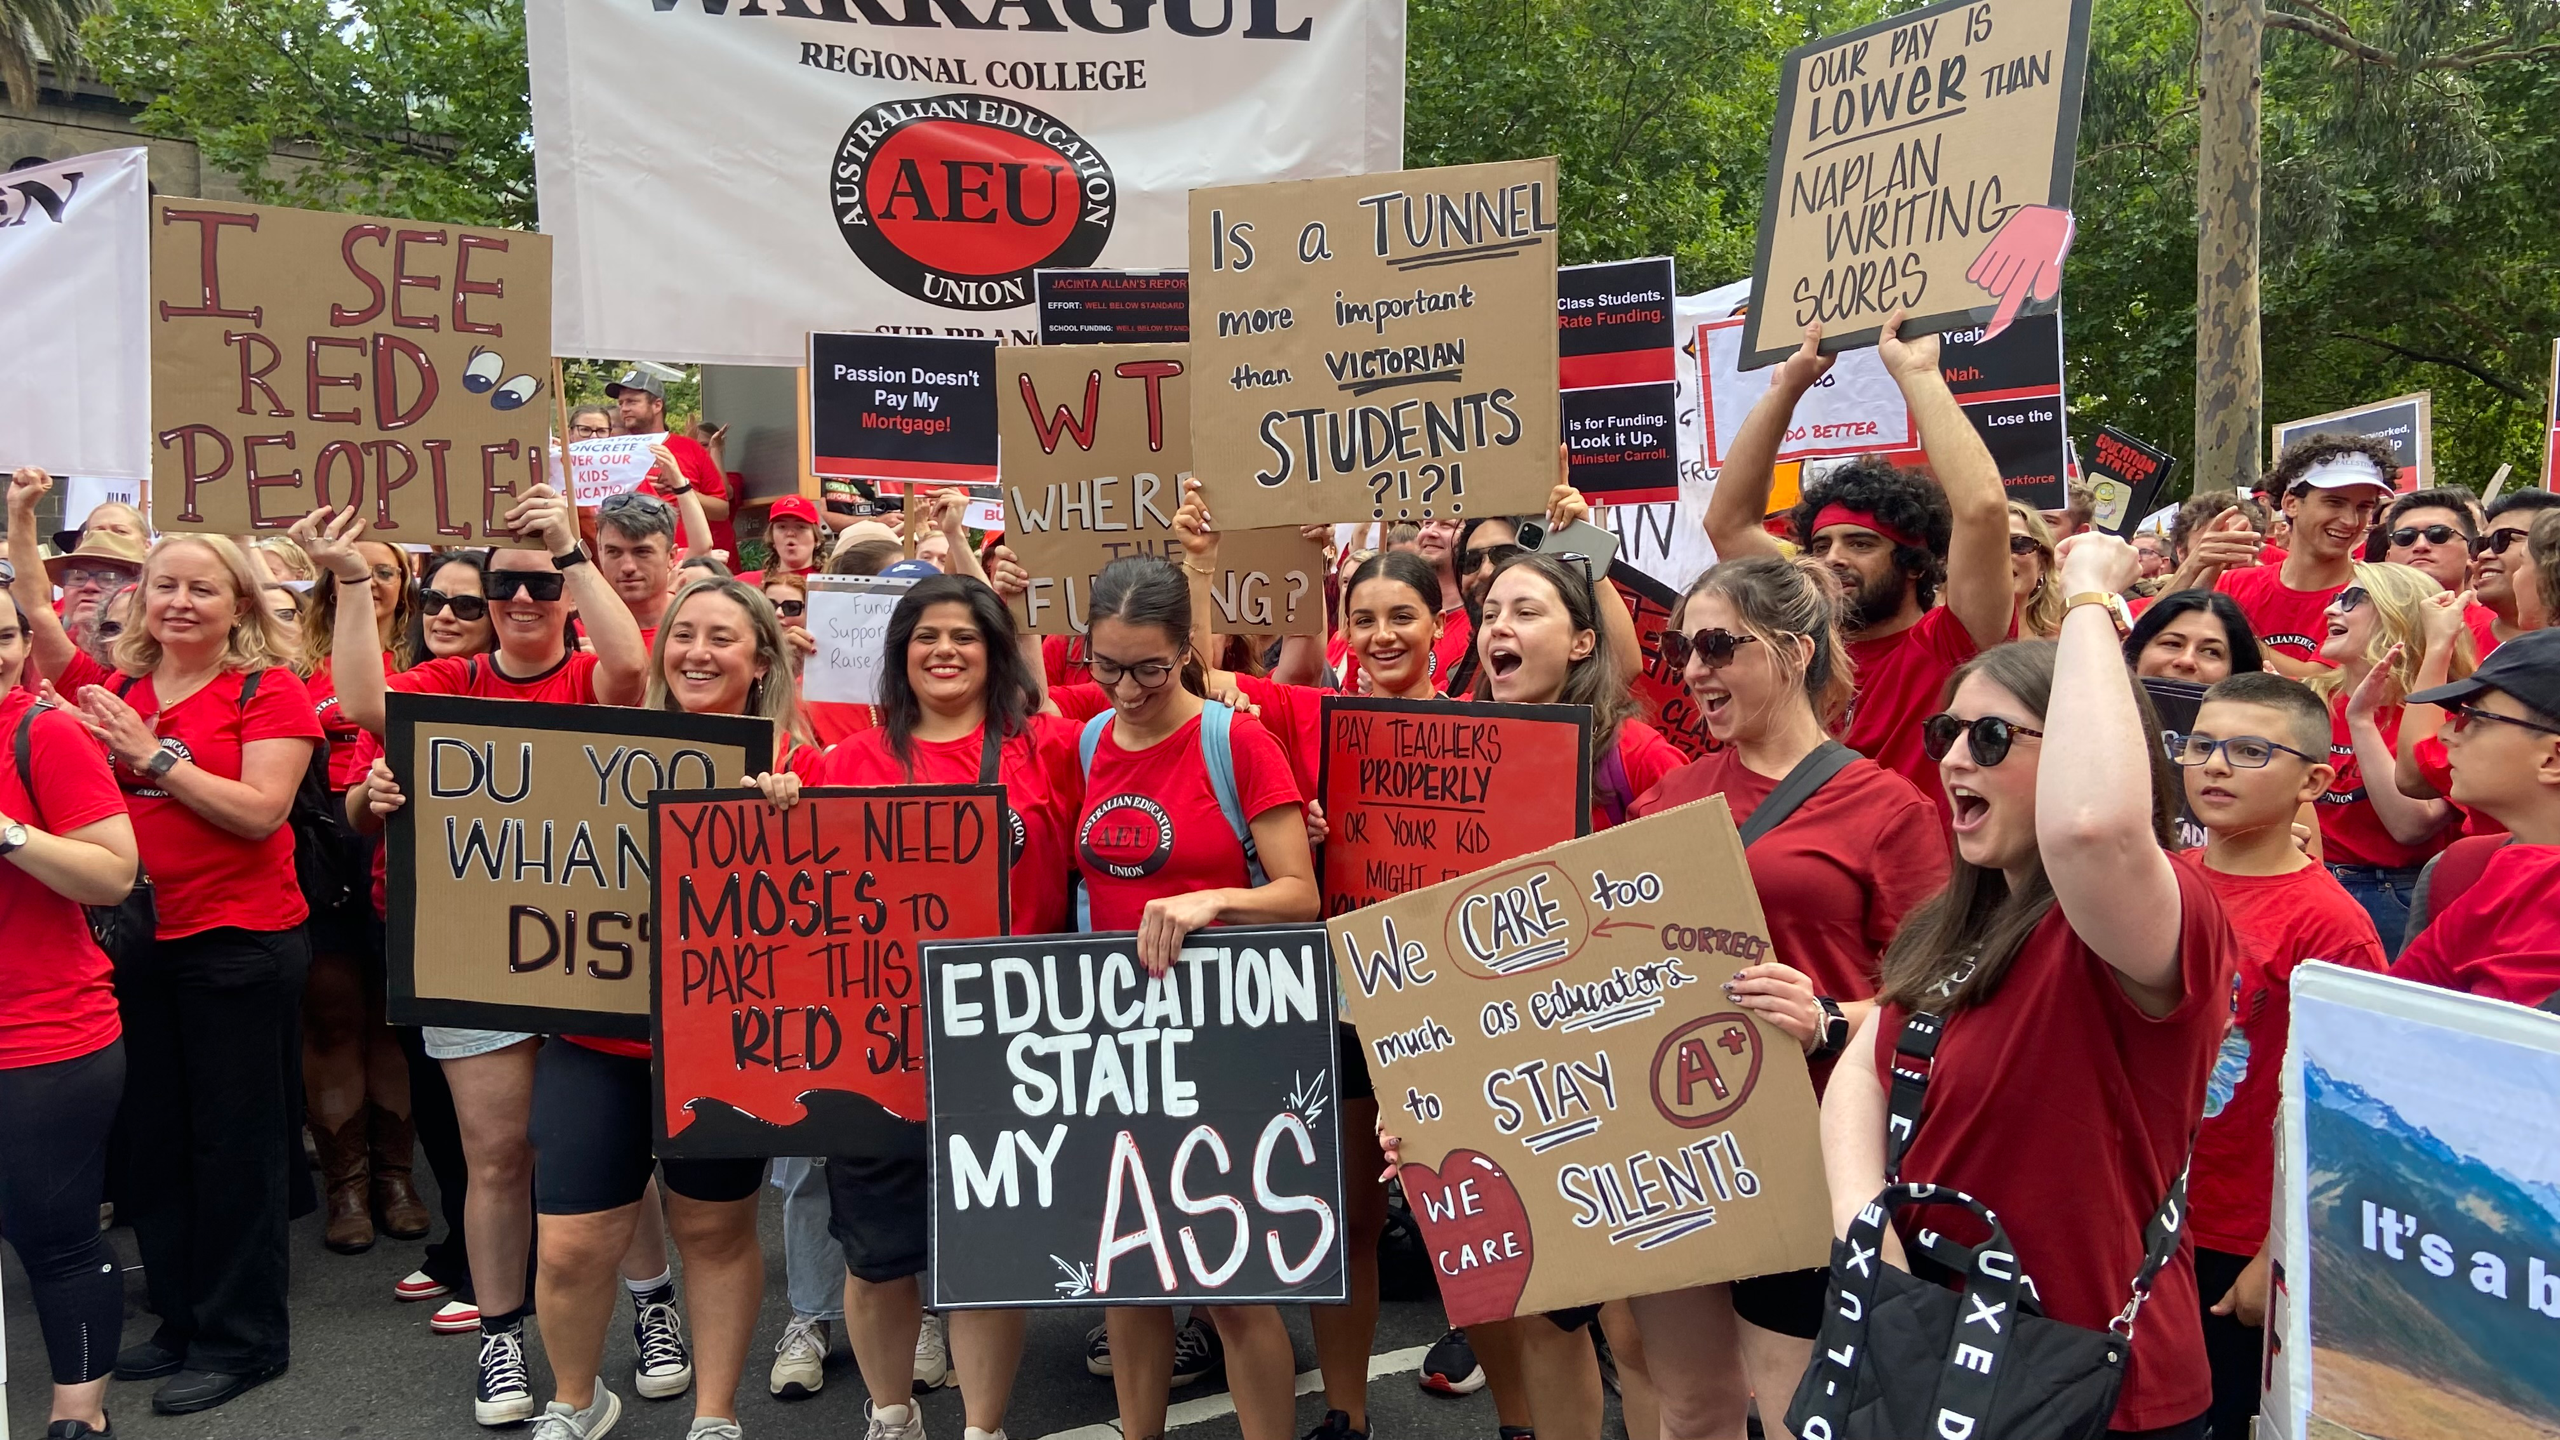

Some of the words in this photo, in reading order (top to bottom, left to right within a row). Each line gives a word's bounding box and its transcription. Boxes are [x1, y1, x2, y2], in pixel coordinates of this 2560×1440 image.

[799, 42, 977, 86] REGIONAL
[985, 59, 1147, 91] COLLEGE
[1809, 40, 1868, 93] OUR
[1890, 18, 1939, 68] PAY
[1965, 3, 1993, 46] IS
[1981, 50, 2052, 99] THAN
[835, 99, 970, 227] AUSTRALIAN
[977, 100, 1110, 228] EDUCATION
[1790, 133, 1942, 218] NAPLAN
[877, 158, 1064, 227] AEU
[1298, 222, 1332, 264] a
[1358, 182, 1557, 257] TUNNEL
[1826, 175, 2021, 263] WRITING
[159, 206, 263, 328] I
[330, 222, 510, 338] SEE
[923, 274, 1026, 305] UNION
[1052, 279, 1098, 289] JACINTA
[1101, 279, 1146, 289] ALLAN'S
[1149, 279, 1188, 289] REPOR
[1048, 302, 1082, 310] EFFORT:
[1085, 302, 1107, 310] WELL
[1110, 302, 1138, 310] BELOW
[1218, 307, 1294, 338] more
[1334, 283, 1475, 335] important
[1558, 296, 1594, 311] Class
[1598, 290, 1665, 307] Students.
[1559, 316, 1592, 328] Rate
[1597, 308, 1665, 326] Funding.
[225, 332, 439, 430] RED
[834, 364, 906, 384] Passion
[912, 367, 980, 387] Doesn't
[1230, 364, 1293, 391] than
[1325, 338, 1465, 382] VICTORIAN
[1946, 366, 1985, 383] Nah.
[862, 412, 951, 436] Mortgage!
[875, 390, 908, 411] Pay
[913, 391, 939, 412] My
[1570, 419, 1582, 431] is
[1585, 416, 1603, 429] for
[1607, 414, 1668, 429] Funding.
[1988, 414, 2025, 427] Lose
[2028, 410, 2053, 423] the
[558, 443, 638, 453] ONCRETE
[1256, 388, 1521, 488] STUDENTS
[1571, 434, 1611, 449] Look
[1615, 432, 1627, 446] it
[1630, 431, 1658, 446] Up,
[1785, 426, 1807, 443] DO
[1812, 421, 1878, 438] BETTER
[2095, 433, 2157, 474] EDUCATION
[579, 470, 609, 482] KIDS
[600, 454, 631, 465] OUR
[1572, 453, 1621, 465] Minister
[1624, 449, 1670, 462] Carroll.
[2095, 450, 2145, 485] STATE?
[159, 423, 543, 542] PEOPLE!
[1368, 463, 1465, 518] ?!?!
[1024, 570, 1309, 634] FUNG?
[831, 647, 872, 669] Raise
[1336, 715, 1373, 755] PAY
[1387, 718, 1501, 764] TEACHERS
[429, 738, 532, 804] DU
[1360, 758, 1492, 803] PROPERLY
[669, 802, 840, 868] YOU'LL
[864, 800, 984, 864] NEED
[1096, 826, 1153, 848] AEU
[1132, 797, 1173, 850] EDUCATION
[1345, 812, 1370, 844] OR
[1384, 813, 1436, 850] YOUR
[1109, 864, 1145, 877] UNION
[1366, 859, 1427, 893] MIGHT
[679, 870, 887, 940] MOSES
[900, 893, 949, 932] TO
[1344, 917, 1436, 998] We
[1458, 872, 1570, 965] CARE
[1591, 870, 1663, 912] too
[1661, 923, 1770, 966] CORRECT
[682, 943, 789, 1005] PART
[808, 939, 912, 999] THIS
[942, 946, 1318, 1036] EDUCATION
[732, 1005, 842, 1072] RED
[1372, 1016, 1454, 1067] much
[1481, 998, 1521, 1038] as
[1006, 1027, 1199, 1117] STATE
[1404, 1087, 1442, 1122] to
[1483, 1050, 1617, 1134] STAY
[1677, 1026, 1747, 1106] A+
[949, 1123, 1069, 1210] MY
[1094, 1111, 1336, 1292] ASS
[1422, 1178, 1484, 1224] WE
[1558, 1131, 1761, 1229] SILENT!
[1438, 1230, 1524, 1277] CARE
[2469, 1251, 2508, 1299] a
